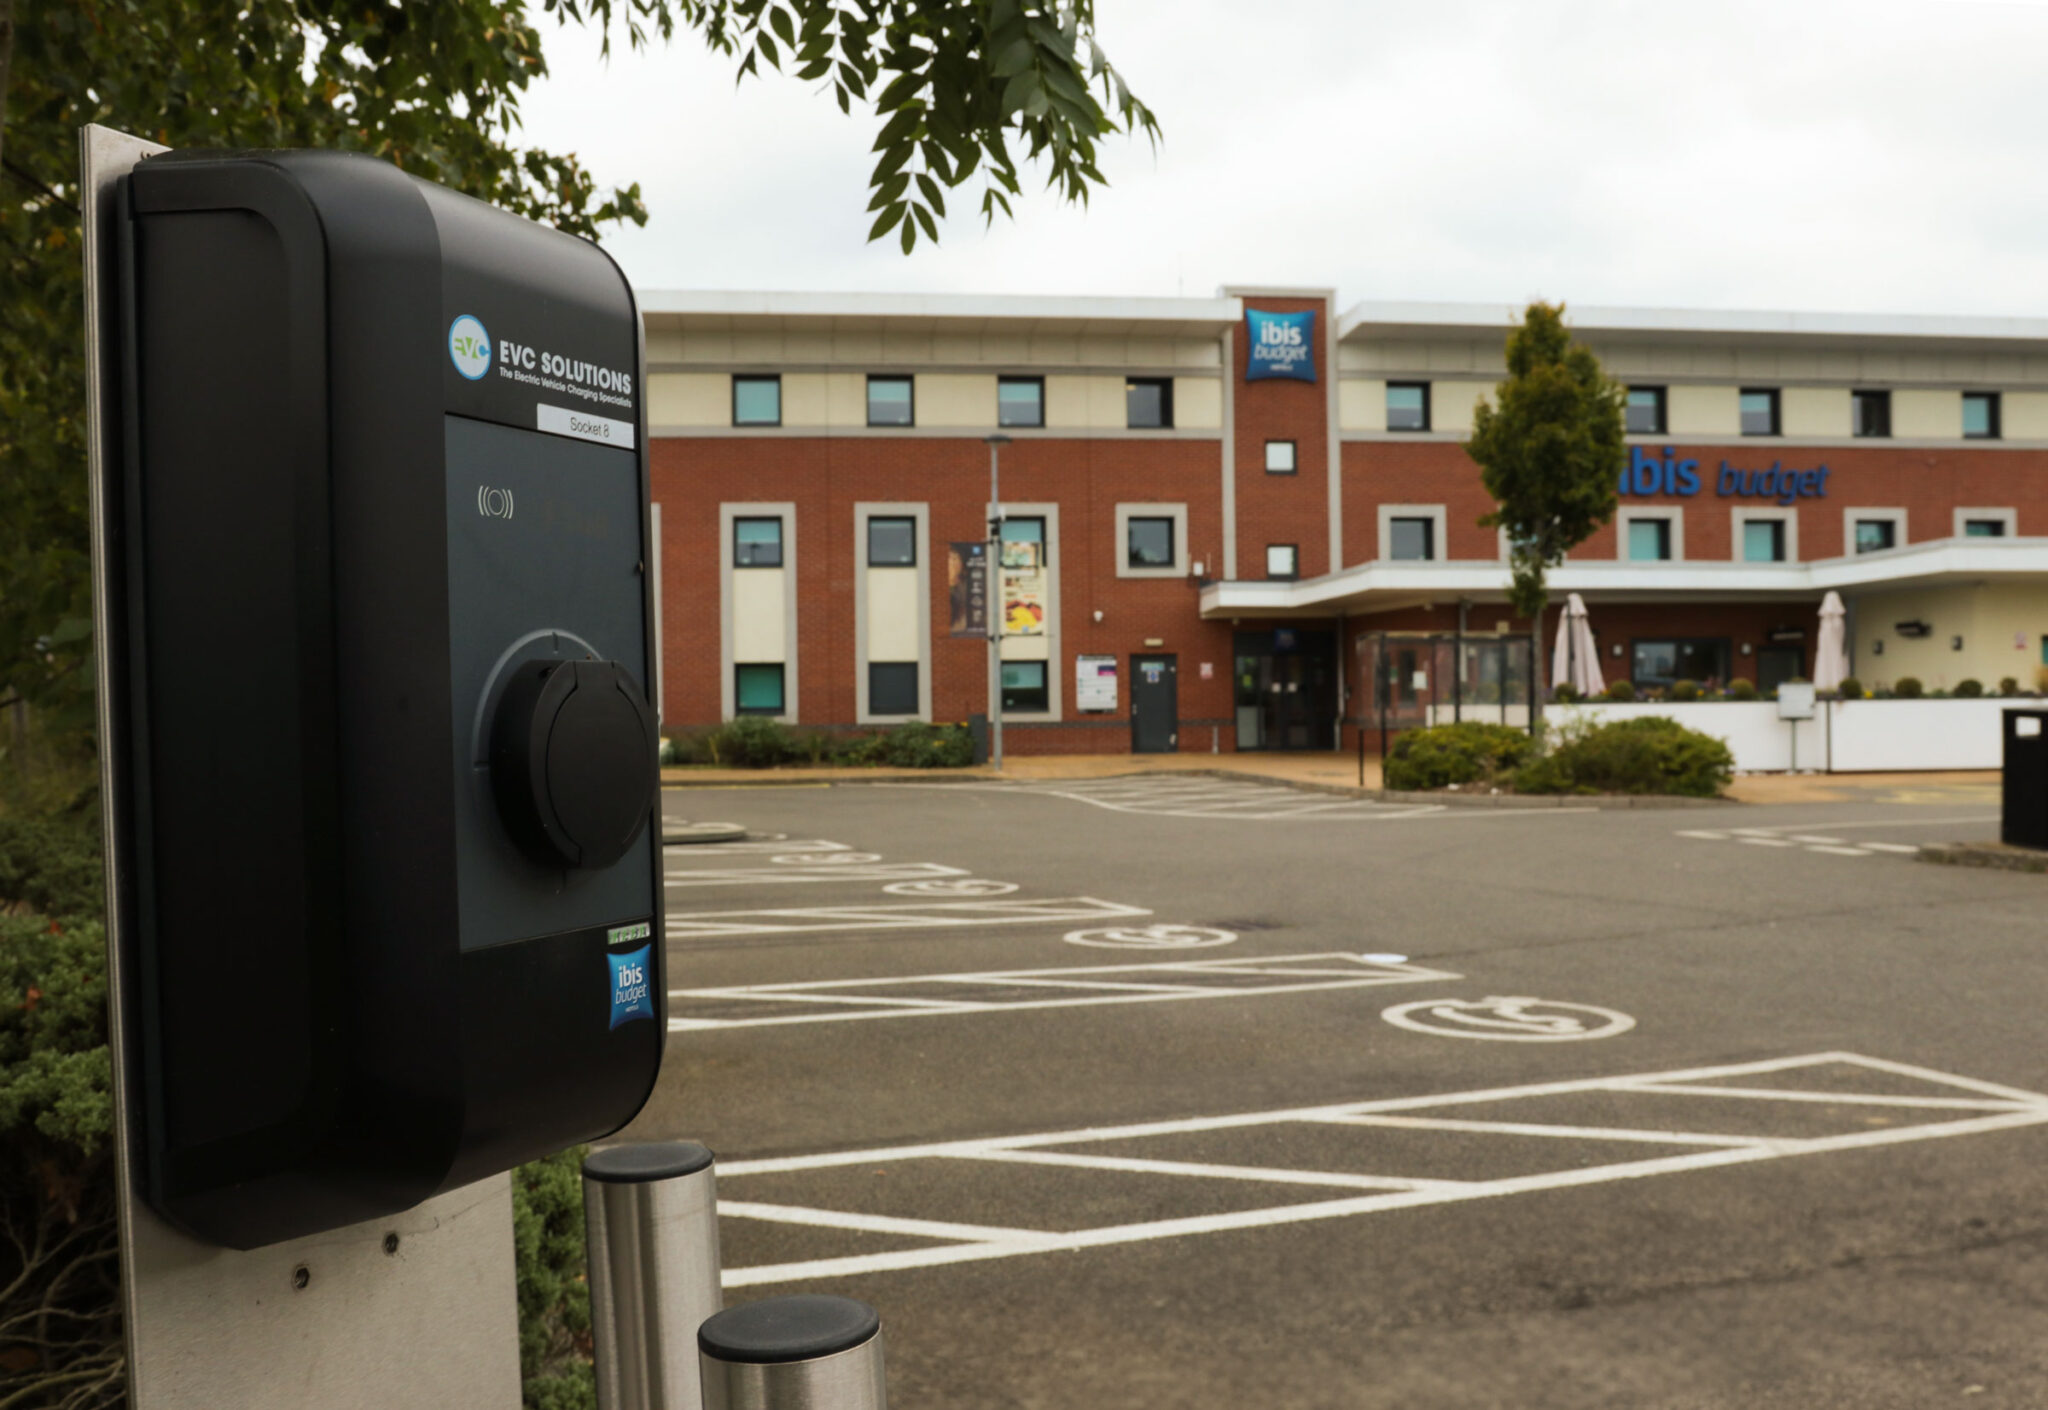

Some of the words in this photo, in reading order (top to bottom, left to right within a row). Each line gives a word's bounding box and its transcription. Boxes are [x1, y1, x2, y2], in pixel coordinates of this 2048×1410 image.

[1261, 320, 1302, 345] ibis
[1254, 344, 1308, 364] budget
[500, 340, 536, 369] EVC
[541, 352, 631, 394] SOLUTIONS
[500, 366, 513, 378] The
[514, 370, 540, 386] Electric
[541, 377, 566, 392] Vehicle
[567, 384, 599, 402] Charging
[599, 392, 632, 408] Specialists
[570, 416, 602, 436] Socket
[603, 424, 610, 438] 8
[1716, 459, 1831, 505] budget
[619, 963, 643, 988] ibis
[615, 983, 647, 1005] budget
